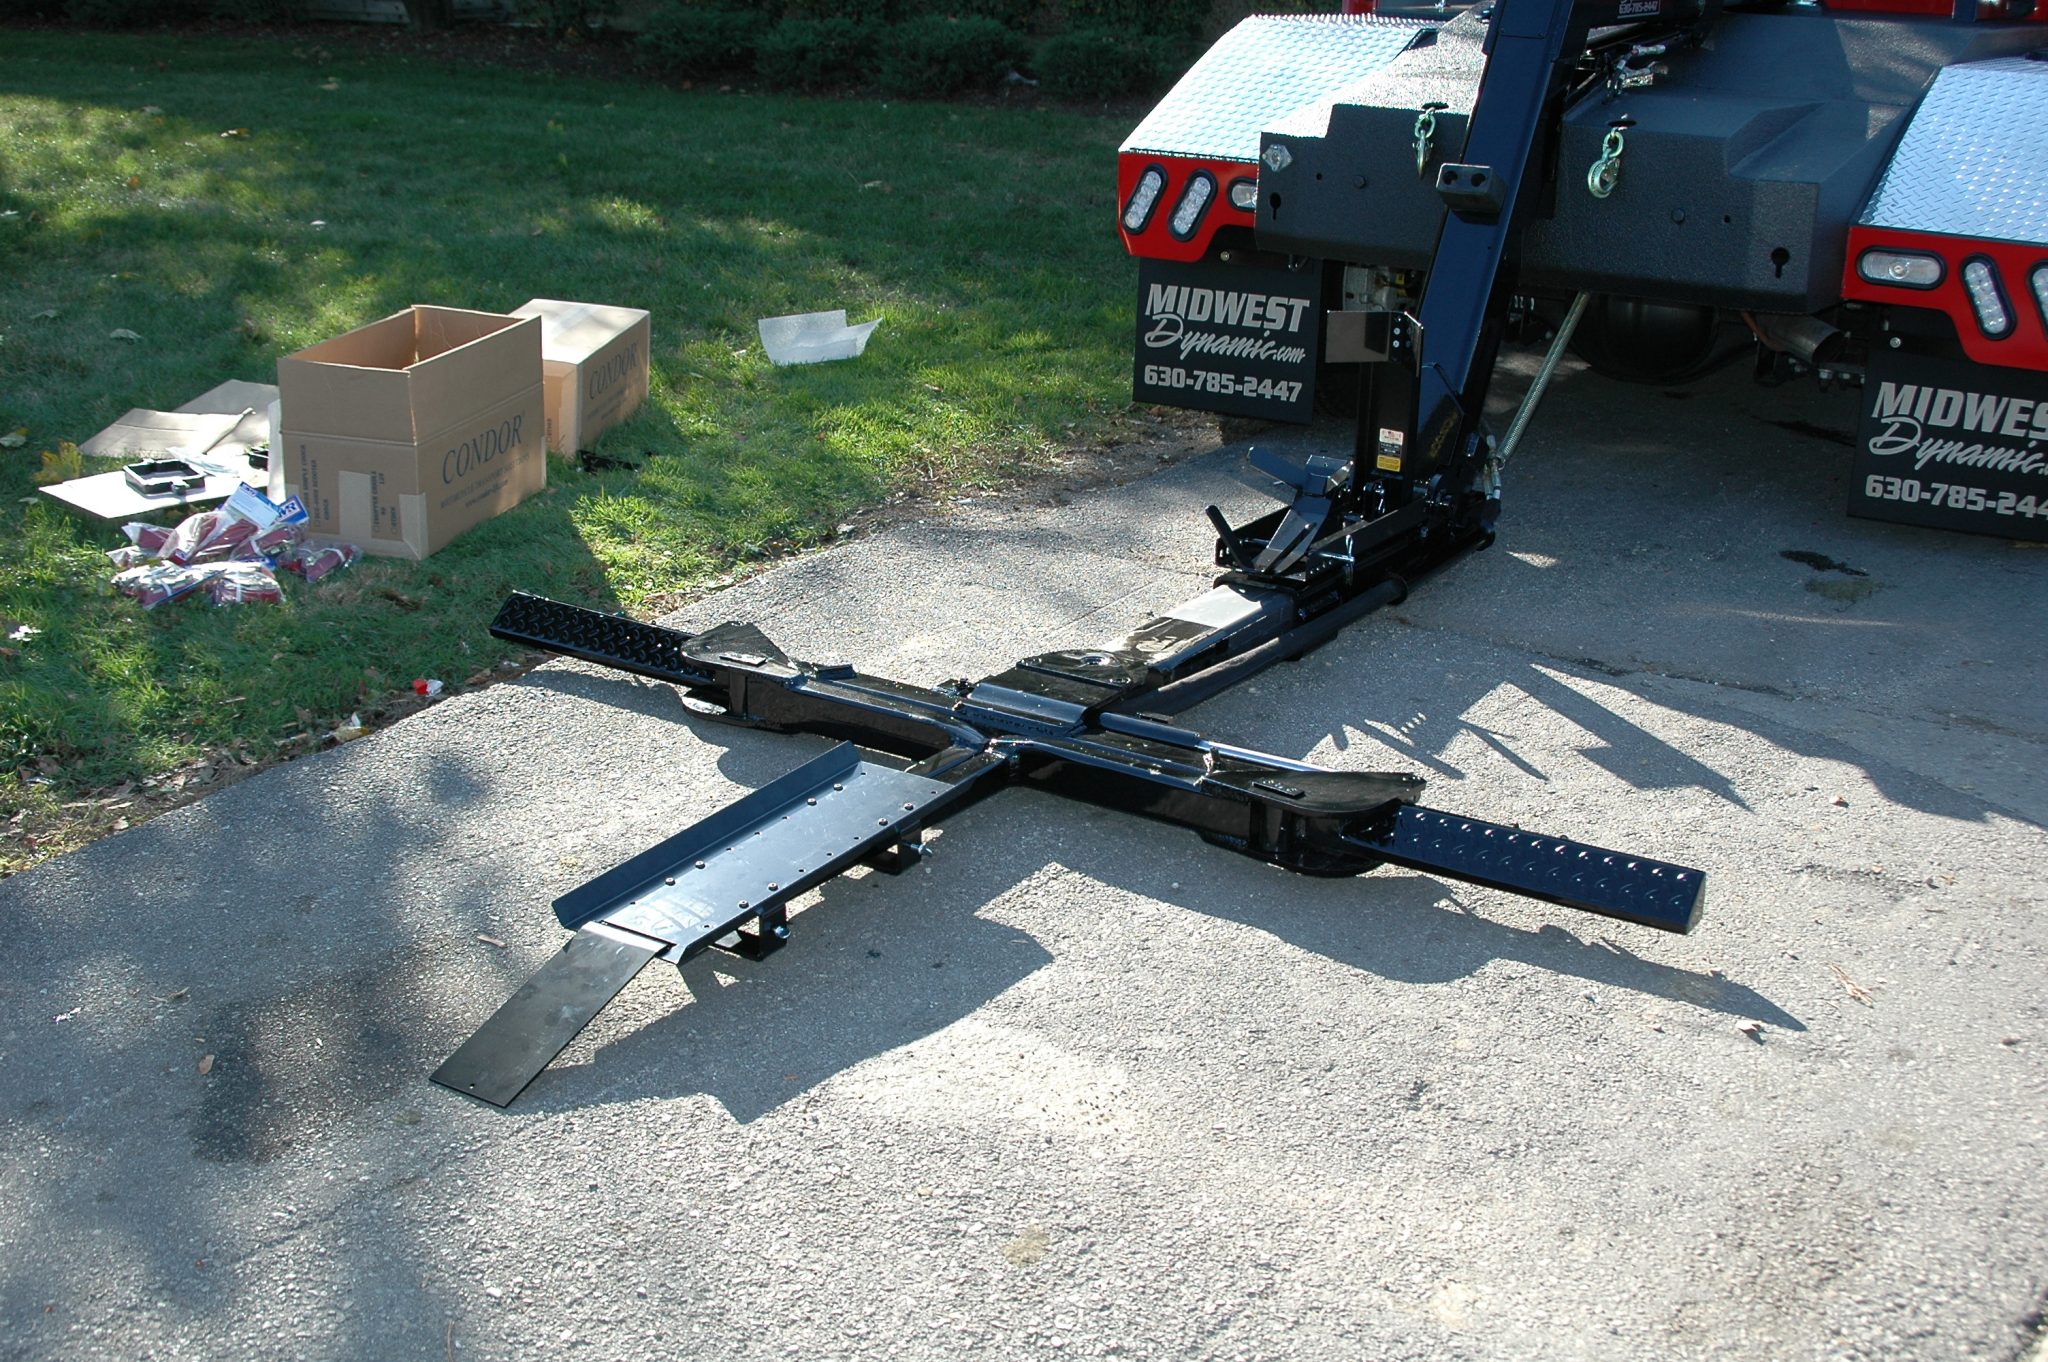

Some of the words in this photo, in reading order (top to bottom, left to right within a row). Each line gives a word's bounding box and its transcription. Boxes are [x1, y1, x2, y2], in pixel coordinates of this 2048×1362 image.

[1144, 283, 1310, 333] MIDWEST
[1144, 313, 1306, 364] Dynamic.com
[588, 342, 637, 400] CONDOR
[1144, 364, 1303, 403] 630-785-2447
[442, 414, 523, 485] CONDOR
